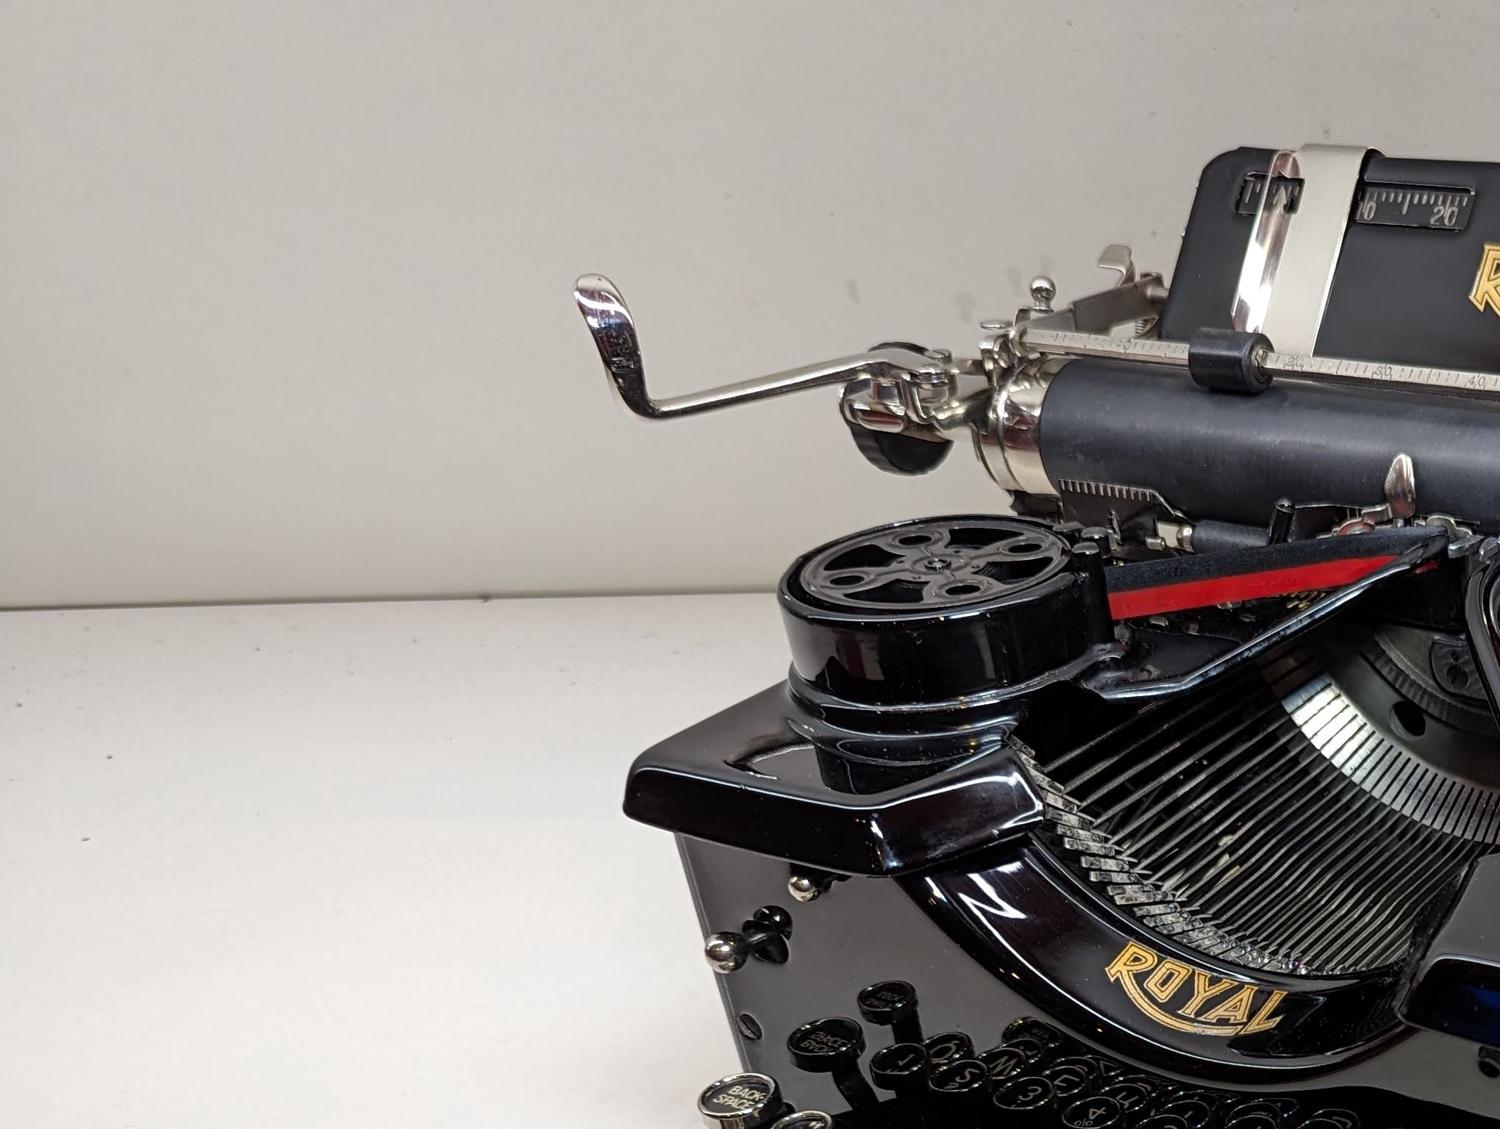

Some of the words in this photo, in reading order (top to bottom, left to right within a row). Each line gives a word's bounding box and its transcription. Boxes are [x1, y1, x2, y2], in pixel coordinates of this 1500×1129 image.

[1430, 206, 1459, 227] 20
[1105, 941, 1288, 1037] ROYAL
[713, 1094, 754, 1110] SPACE
